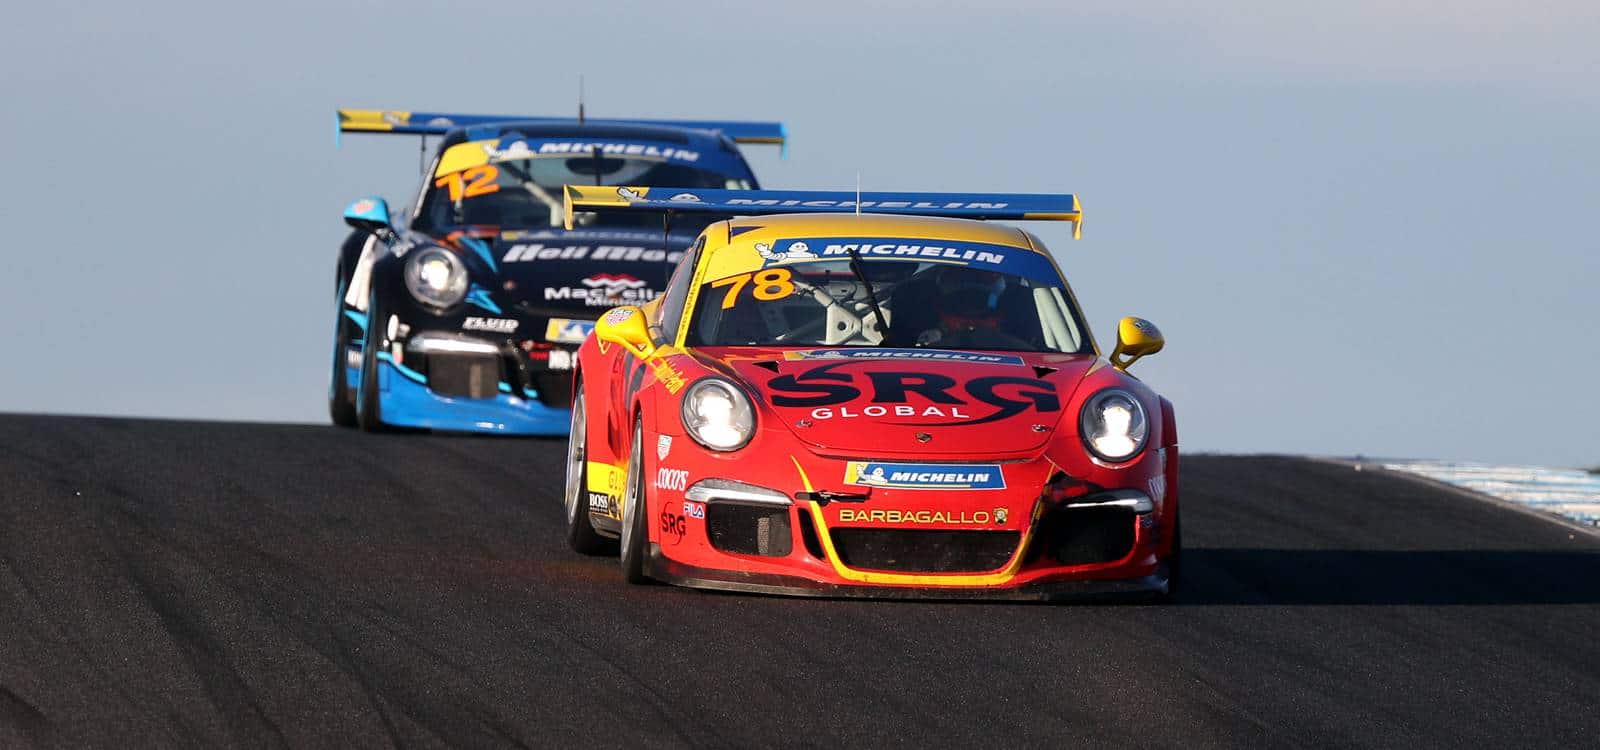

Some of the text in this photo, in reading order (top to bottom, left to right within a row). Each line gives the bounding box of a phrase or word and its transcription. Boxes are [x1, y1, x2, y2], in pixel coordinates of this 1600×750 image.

[539, 140, 700, 162] MICHELIN
[434, 165, 500, 201] 12
[725, 198, 1009, 210] MICHELIN
[823, 243, 1005, 266] MICHELIN
[711, 268, 795, 310] 78
[852, 351, 1001, 363] MICHELIN
[767, 361, 1061, 422] SRG
[811, 406, 970, 420] GLOBAL
[890, 470, 990, 484] MICHELIN
[589, 493, 608, 508] BOSS
[683, 503, 705, 519] FILA
[839, 508, 990, 525] BARBAGALLO
[660, 507, 687, 541] SRG
